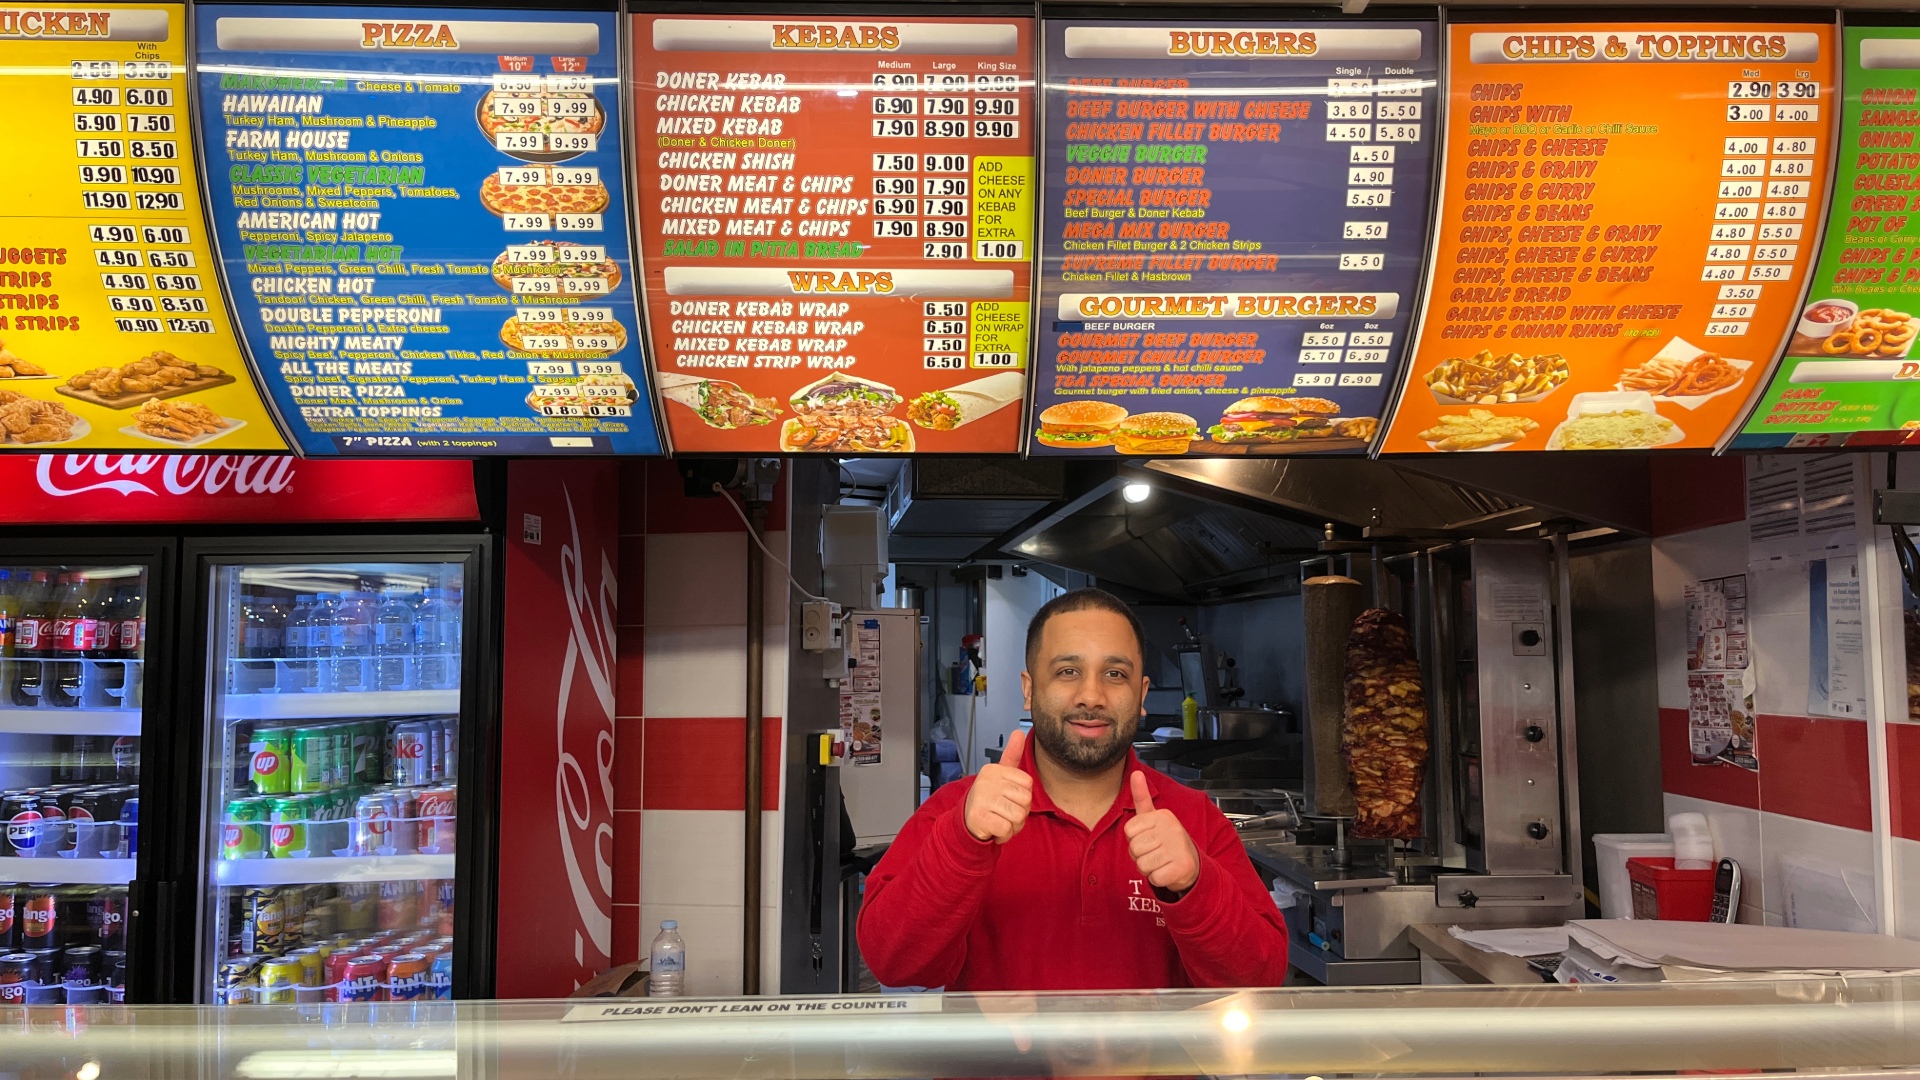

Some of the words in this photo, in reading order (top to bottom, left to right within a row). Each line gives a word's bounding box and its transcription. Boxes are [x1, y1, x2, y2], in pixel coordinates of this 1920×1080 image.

[362, 23, 457, 47] PIZZA
[773, 25, 899, 48] KEBABS
[1170, 32, 1317, 54] BURGERS
[1503, 35, 1596, 58] CHIPS
[1605, 35, 1627, 57] &
[1636, 35, 1786, 58] TOPPINGS
[135, 52, 160, 60] Chips
[878, 61, 911, 69] Medium
[933, 62, 956, 71] Large
[978, 62, 997, 71] King
[999, 62, 1016, 70] Size
[1336, 67, 1362, 76] Single
[1385, 67, 1414, 75] Double
[1796, 70, 1810, 79] Lrg
[77, 89, 112, 104] 4.90
[126, 89, 168, 105] 6.00
[1732, 82, 1771, 98] 2.90
[1861, 88, 1917, 105] ONION
[223, 95, 323, 113] HAWAIIAN
[656, 95, 735, 113] CHICKEN
[740, 96, 801, 113] KEBAB
[875, 98, 913, 114] 6.90
[927, 99, 964, 114] 7.90
[975, 99, 1014, 115] 9.90
[1067, 101, 1113, 118] BEEF
[1117, 101, 1189, 120] BURGER
[1193, 102, 1241, 119] WITH
[1244, 101, 1312, 119] CHEESE
[1332, 105, 1369, 117] 3.80
[1380, 105, 1416, 117] 5.50
[1729, 106, 1763, 120] 3.00
[1777, 110, 1808, 121] 4.00
[225, 115, 264, 128] Turkey
[268, 115, 298, 128] Ham,
[302, 116, 363, 127] Mushroom
[366, 116, 375, 127] &
[379, 117, 436, 130] Pineapple
[226, 131, 280, 148] FARM
[286, 131, 349, 148] HOUSE
[658, 138, 695, 148] (Doner
[699, 138, 707, 147] &
[711, 138, 754, 148] Chicken
[758, 138, 796, 149] Doner)
[1066, 145, 1132, 164] VEGGIE
[1135, 145, 1208, 164] BURGER
[1468, 139, 1521, 157] CHIPS
[1524, 139, 1537, 156] &
[1541, 138, 1608, 157] CHEESE
[1353, 150, 1389, 162] 4.50
[978, 162, 1002, 172] ADD
[230, 165, 303, 184] CLASSIC
[308, 166, 425, 186] VEGETARIAN
[505, 172, 539, 183] 7.99
[556, 172, 592, 183] 9.99
[978, 175, 1025, 186] CHEESE
[660, 174, 722, 193] DONER
[727, 175, 778, 192] MEAT
[783, 176, 795, 192] &
[801, 176, 854, 193] CHIPS
[978, 189, 995, 198] ON
[998, 189, 1022, 198] ANY
[1063, 188, 1134, 207] SPECIAL
[1139, 189, 1212, 208] BURGER
[978, 202, 1016, 212] KEBAB
[1851, 195, 1909, 213] GREEN
[238, 212, 336, 230] AMERICAN
[342, 213, 380, 230] HOT
[978, 215, 1002, 224] FOR
[1065, 208, 1089, 218] Beef
[1091, 208, 1125, 219] Burger
[1128, 208, 1136, 217] &
[1139, 208, 1169, 218] Doner
[1172, 208, 1205, 218] Kebab
[241, 231, 303, 242] Pepperoni,
[306, 232, 337, 243] Spicy
[341, 232, 393, 243] Jalapeno
[978, 228, 1015, 237] EXTRA
[1459, 226, 1512, 245] CHIPS,
[1518, 225, 1584, 243] CHEESE
[1586, 225, 1600, 241] &
[1604, 224, 1662, 243] GRAVY
[1716, 228, 1745, 238] 4.80
[1762, 227, 1792, 238] 5.50
[663, 240, 720, 256] SALAD
[724, 241, 745, 257] IN
[751, 241, 798, 257] PITTA
[804, 241, 864, 258] BREAD
[925, 243, 962, 258] 2.90
[982, 243, 1016, 258] 1.00
[788, 271, 893, 292] WRAPS
[1063, 272, 1102, 281] Chicken
[1105, 272, 1129, 281] Fillet
[1142, 272, 1191, 281] Hasbrown
[670, 302, 730, 317] DONER
[736, 302, 793, 317] KEBAB
[799, 303, 849, 317] WRAP
[926, 303, 964, 316] 6.50
[1079, 296, 1228, 316] GOURMET
[1236, 296, 1377, 315] BURGERS
[1446, 306, 1507, 322] GARLIC
[1509, 306, 1566, 321] BREAD
[1569, 306, 1616, 320] WITH
[1616, 304, 1683, 320] CHEESE
[1717, 306, 1747, 316] 4.50
[16, 316, 80, 331] STRIPS
[260, 308, 332, 323] DOUBLE
[339, 308, 441, 324] PEPPERONI
[116, 319, 159, 332] 10.90
[1304, 352, 1334, 361] 5.70
[1349, 352, 1379, 361] 6.90
[280, 362, 311, 375] ALL
[315, 362, 349, 375] THE
[355, 362, 412, 375] MEATS
[1055, 375, 1086, 387] T&A
[1090, 375, 1155, 387] SPECIAL
[1160, 374, 1227, 387] BURGER
[1780, 388, 1825, 399] CANS
[301, 407, 354, 417] EXTRA
[358, 407, 442, 417] TOPPINGS
[1771, 401, 1840, 413] BOTTLES
[366, 437, 412, 446] PIZZA
[452, 440, 497, 448] toppings)
[36, 454, 296, 497] CocaCola
[1127, 896, 1164, 914] KEB
[601, 1007, 664, 1016] PLEASE
[668, 1005, 717, 1014] DON'T
[720, 1004, 763, 1012] LEAN
[795, 1003, 826, 1011] THE
[832, 1000, 907, 1010] COUNTER
